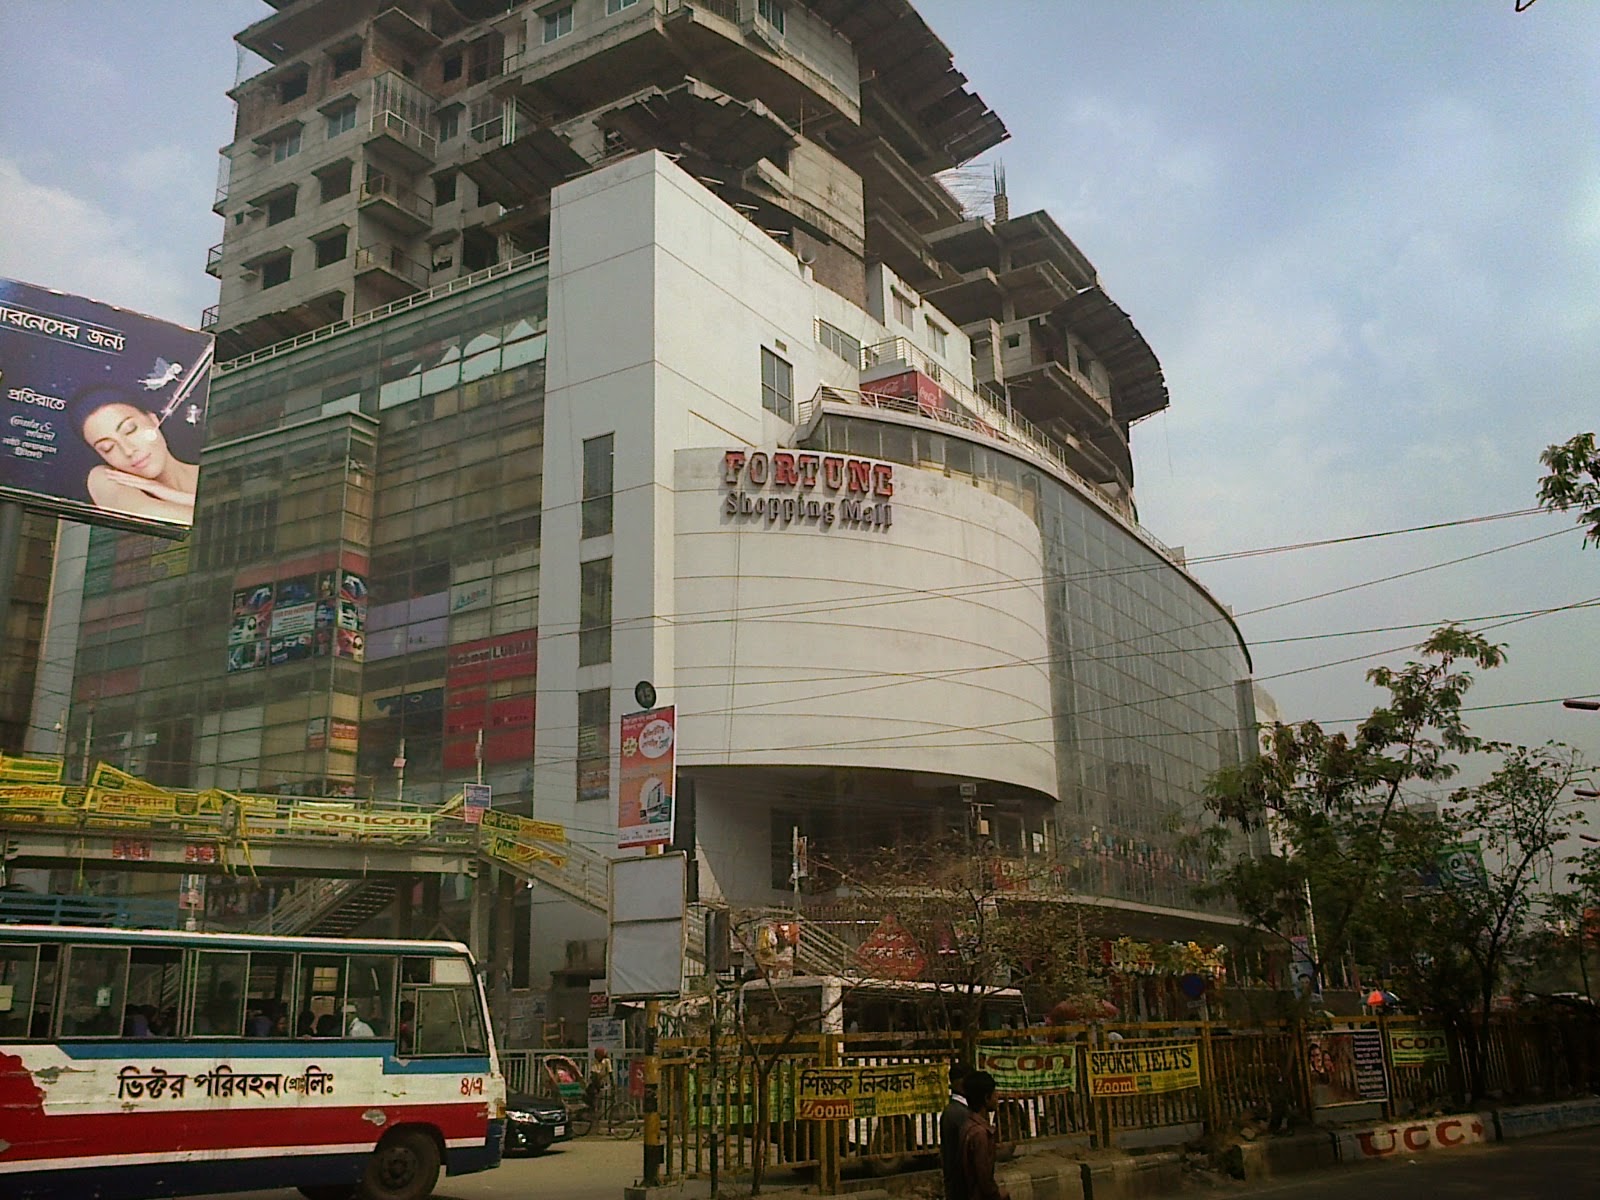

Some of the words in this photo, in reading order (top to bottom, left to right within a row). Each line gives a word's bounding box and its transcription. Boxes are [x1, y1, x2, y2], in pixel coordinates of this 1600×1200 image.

[0, 306, 80, 339] ারনেসের
[87, 328, 126, 351] জন্য
[8, 388, 67, 410] প্রতিরাতে
[724, 451, 893, 496] FORTUNE
[725, 491, 835, 525] Shopping
[841, 498, 893, 528] Mall
[1145, 1047, 1193, 1072] IELTS
[117, 1065, 188, 1099] ভিক্টর
[194, 1065, 283, 1099] পরিবহন
[800, 1069, 853, 1096] শিক্ষক
[859, 1069, 915, 1095] নিবন্ধন
[1095, 1078, 1133, 1095] Zoom
[802, 1100, 850, 1119] Zoom
[1356, 1120, 1465, 1156] UCC
